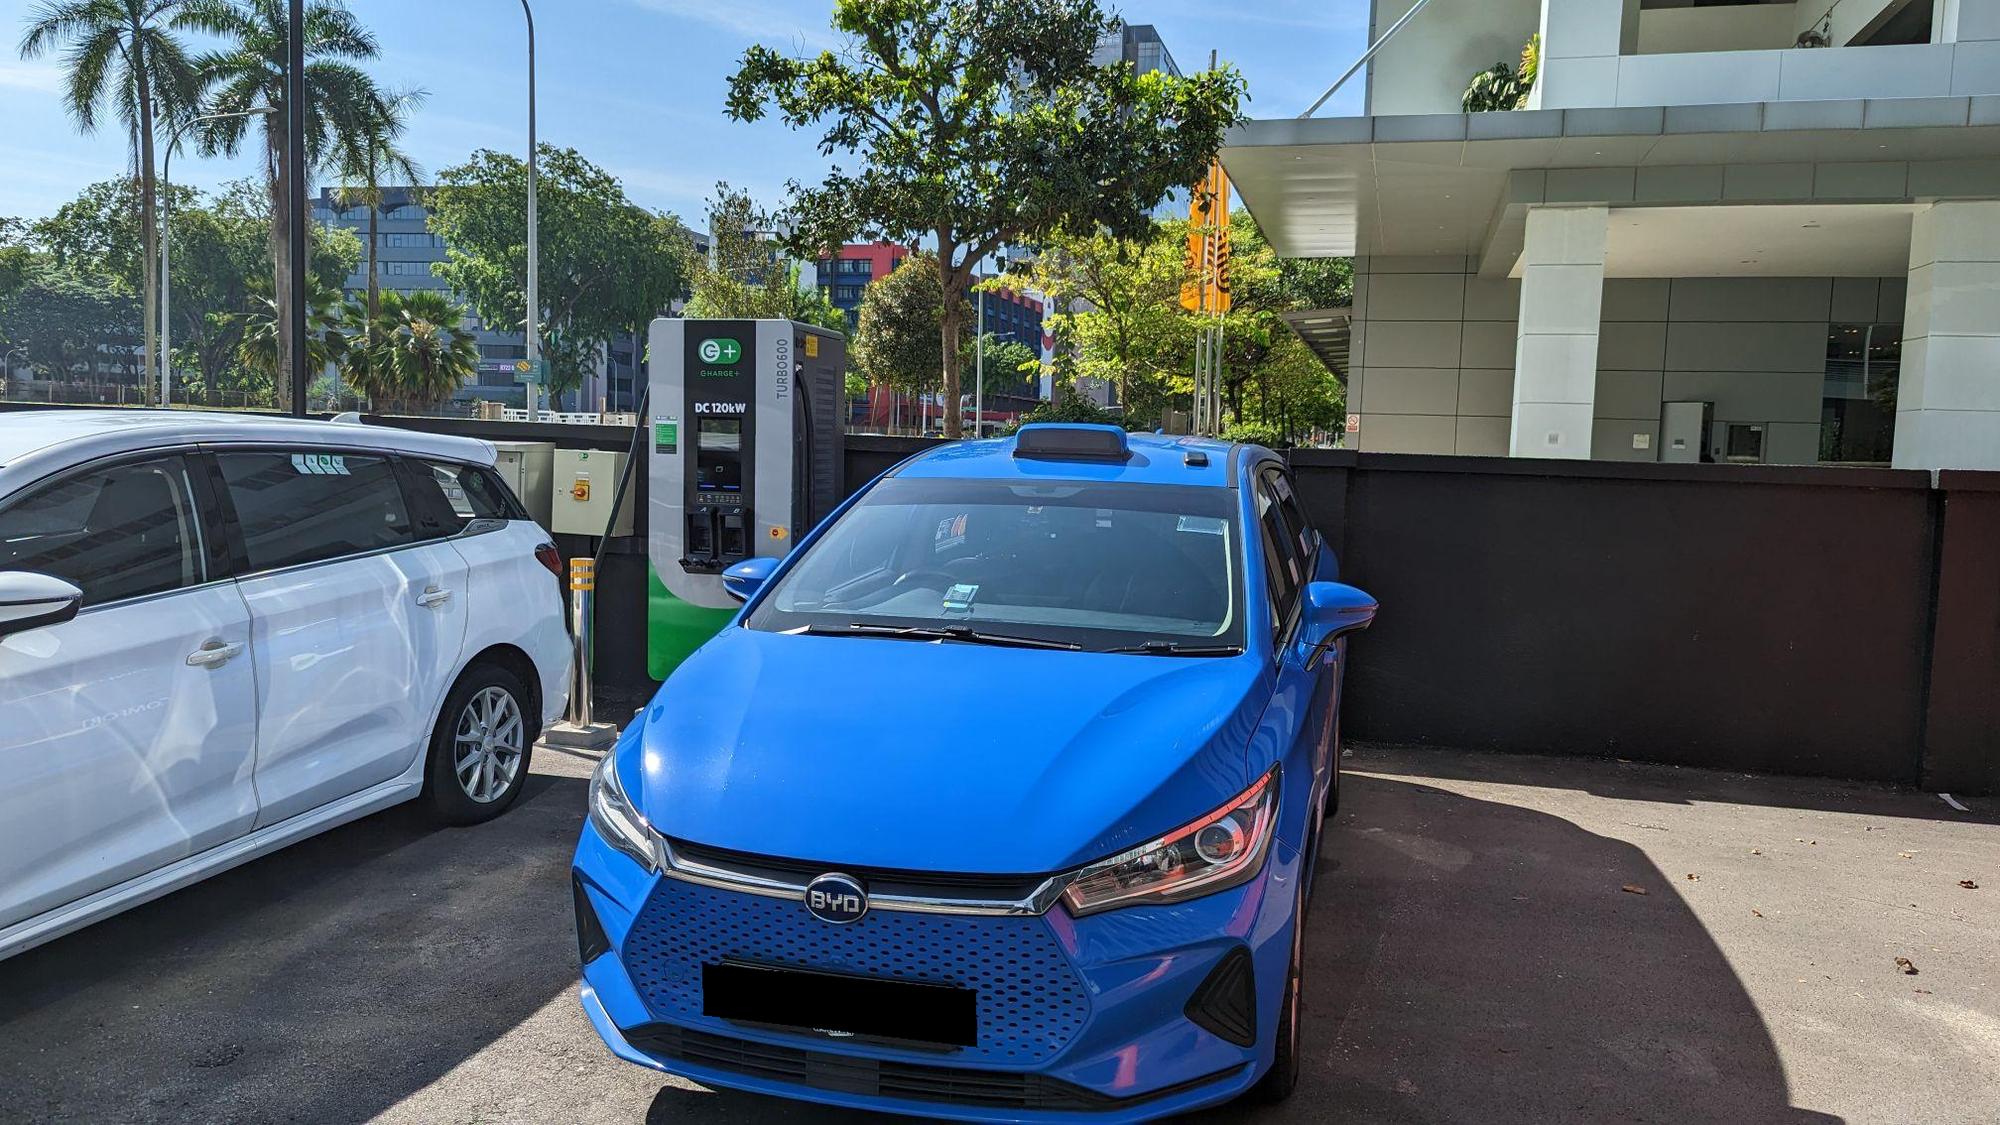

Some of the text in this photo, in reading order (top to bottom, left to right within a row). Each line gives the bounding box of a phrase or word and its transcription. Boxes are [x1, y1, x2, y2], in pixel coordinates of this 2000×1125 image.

[776, 338, 788, 400] TURBO600
[695, 403, 746, 413] DC 120kW
[811, 891, 860, 913] BYD
